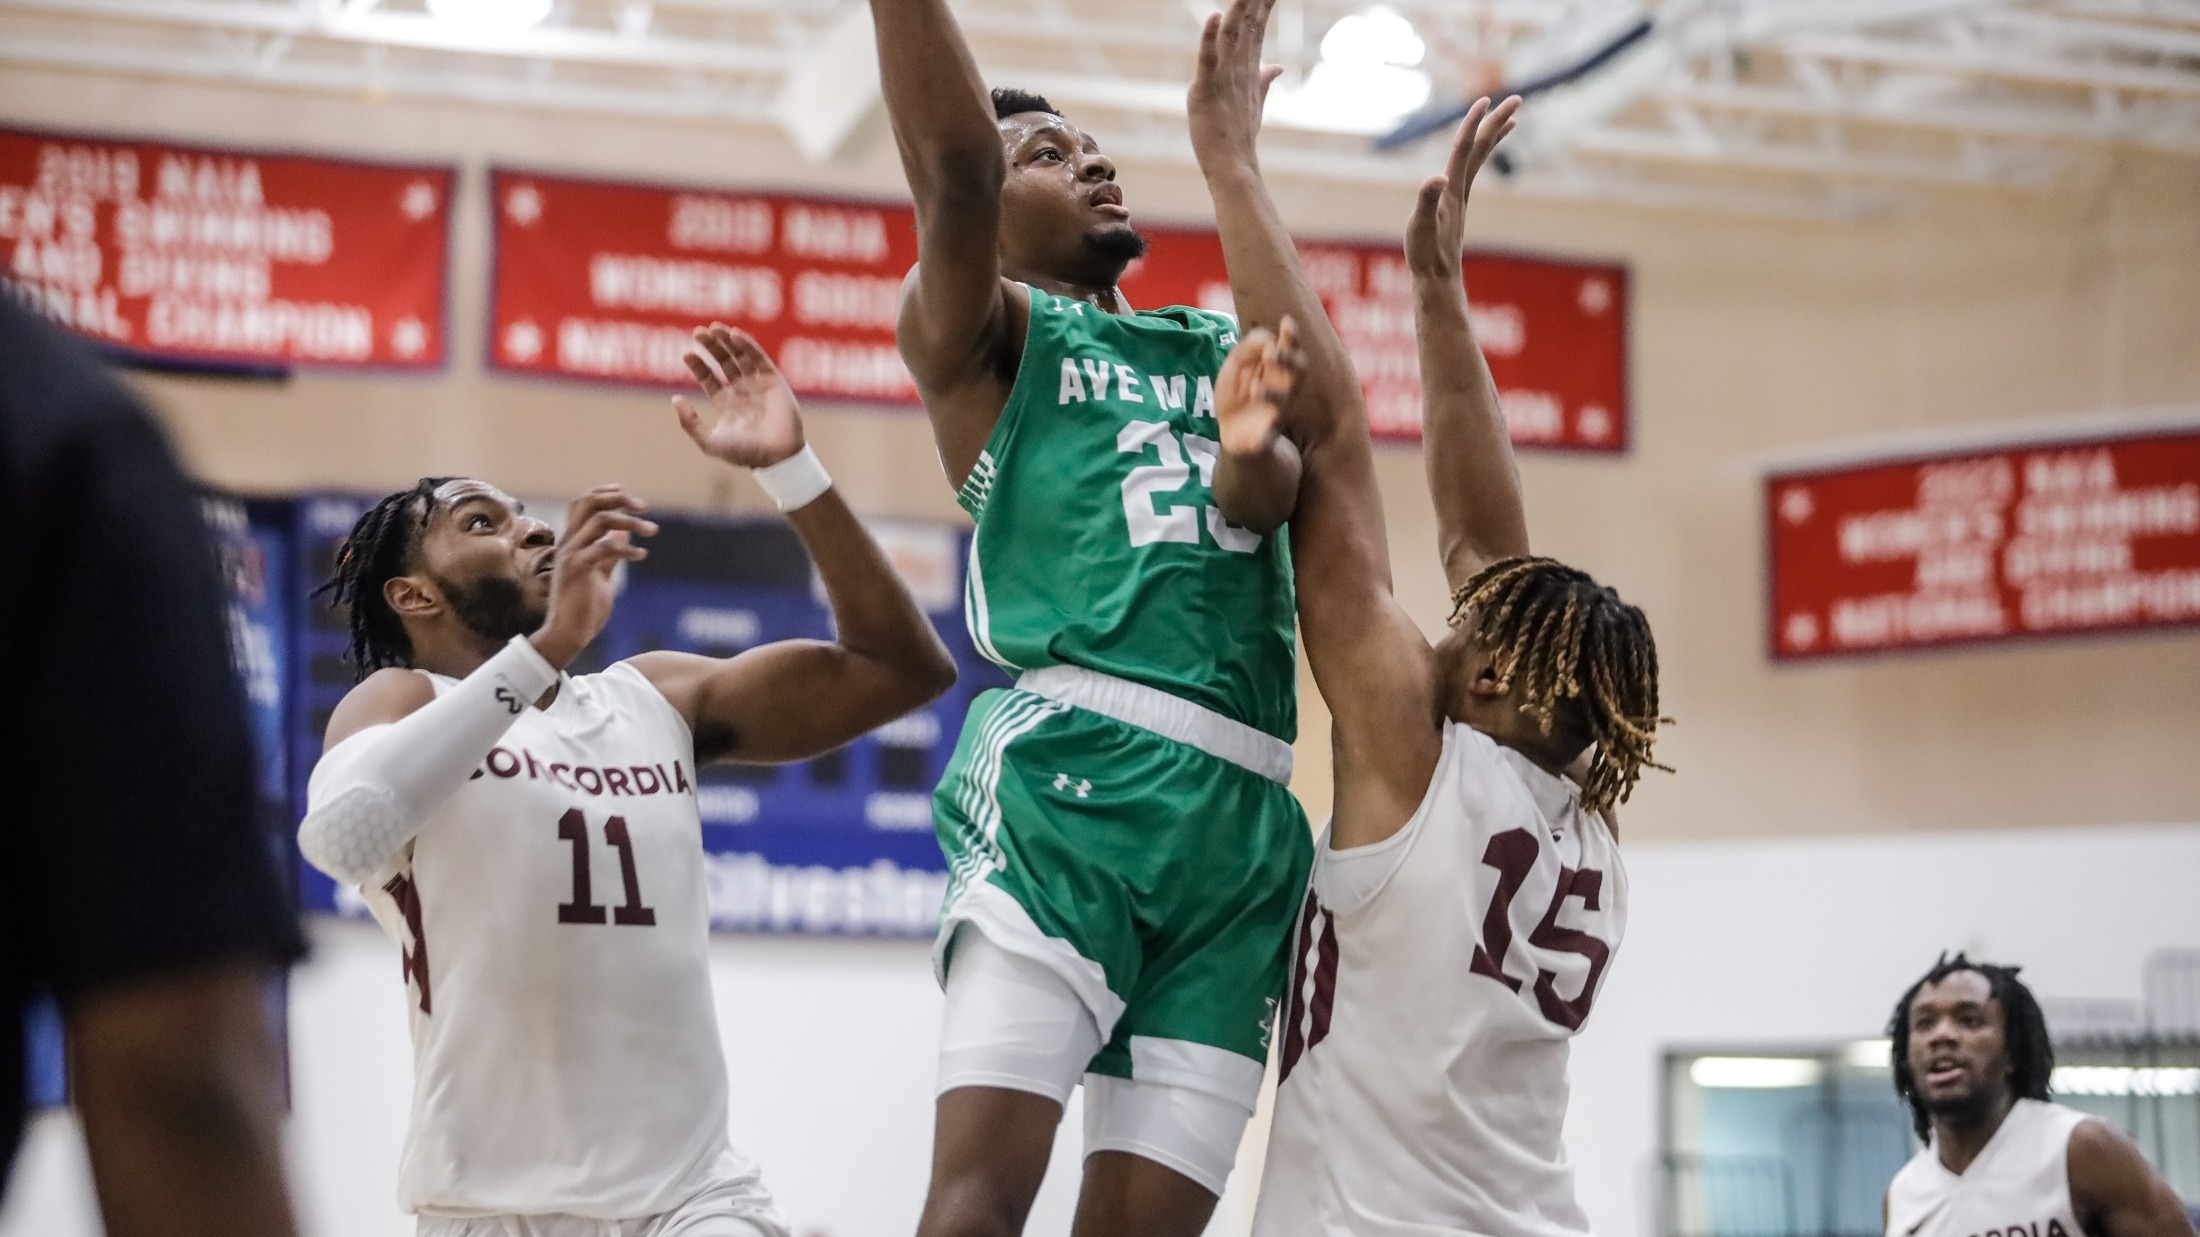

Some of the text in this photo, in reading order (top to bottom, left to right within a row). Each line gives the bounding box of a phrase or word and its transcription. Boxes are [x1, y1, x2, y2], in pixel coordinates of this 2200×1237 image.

[156, 151, 264, 205] NAIA
[0, 185, 333, 264] EN'S SWIMMING
[782, 206, 889, 263] NAIA
[13, 237, 102, 288] AND
[589, 252, 783, 322] WOMEN'S
[147, 298, 373, 361] CHAMPION
[1058, 357, 1143, 405] AVE
[2016, 485, 2199, 542] SWIMMING
[1830, 592, 2003, 645] NATIONAL
[558, 808, 656, 926] 11
[1469, 827, 1610, 1032] 15
